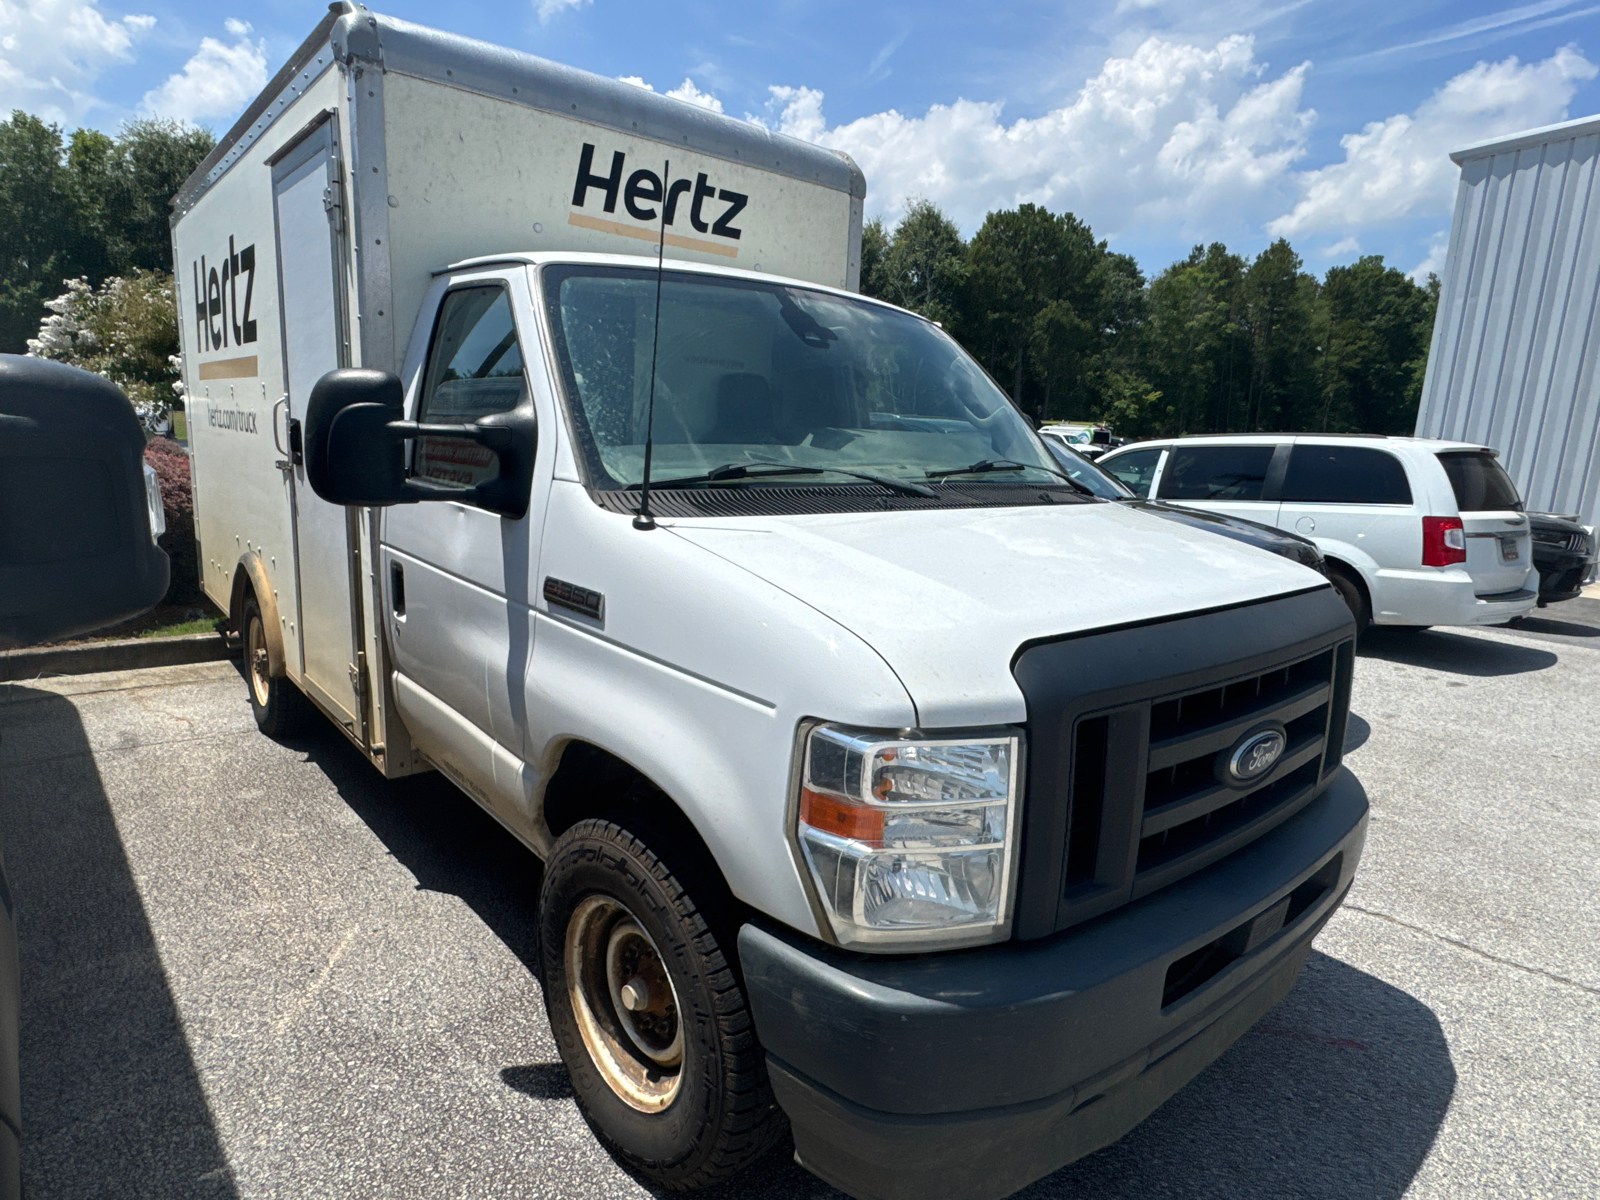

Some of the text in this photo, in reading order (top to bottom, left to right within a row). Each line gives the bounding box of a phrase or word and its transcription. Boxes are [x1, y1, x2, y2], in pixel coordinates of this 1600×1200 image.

[572, 143, 749, 240] Hertz
[193, 234, 258, 354] Hertz
[207, 402, 258, 435] hertz.com/truck
[1249, 740, 1278, 771] Ford
